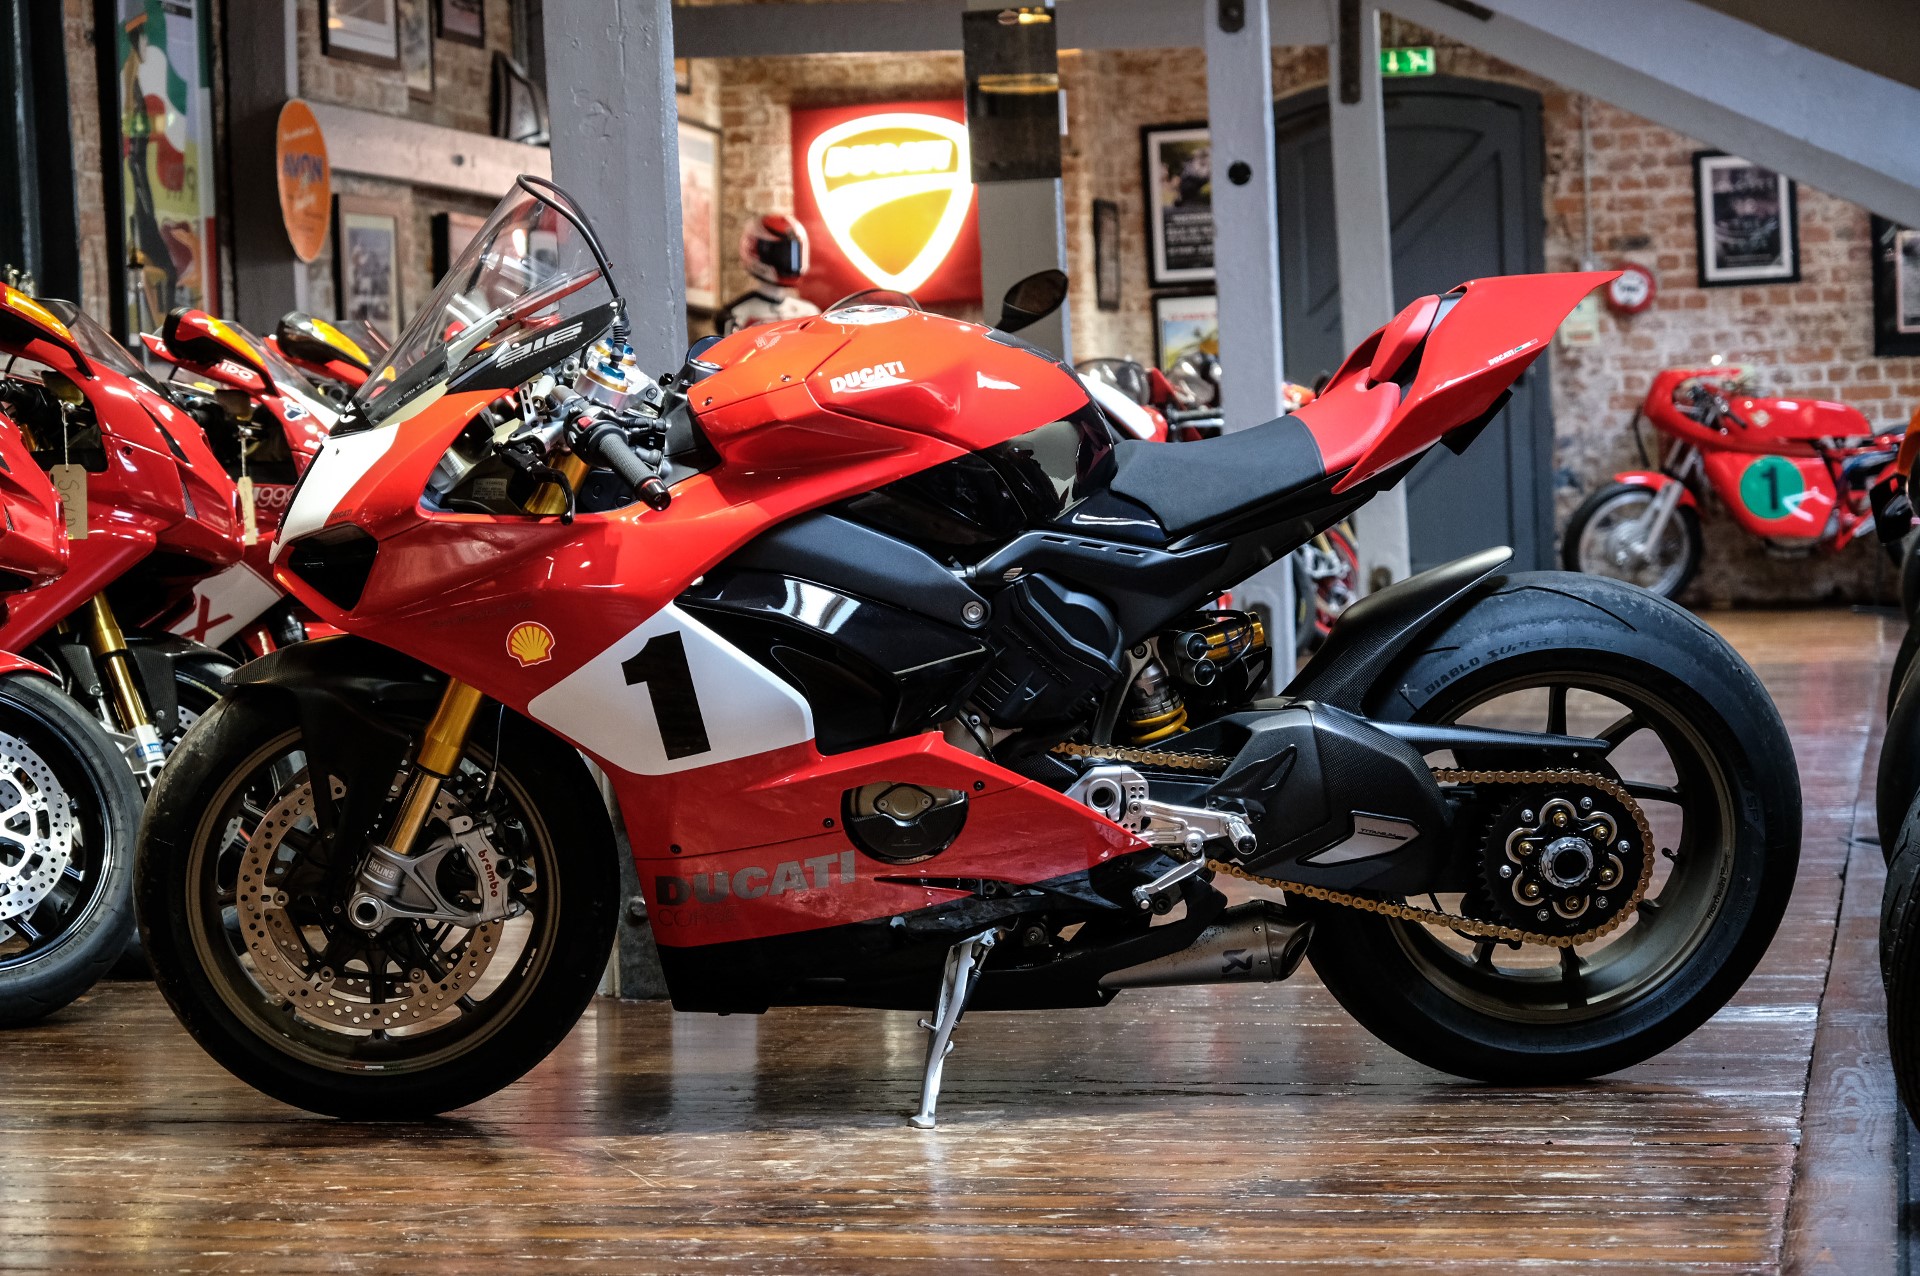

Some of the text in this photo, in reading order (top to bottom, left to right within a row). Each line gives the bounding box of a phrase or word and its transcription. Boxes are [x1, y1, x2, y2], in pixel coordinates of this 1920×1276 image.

[496, 321, 584, 368] 916
[829, 360, 906, 394] DUCATI
[1761, 466, 1779, 511] 1
[621, 630, 712, 761] 1
[1424, 656, 1480, 695] DIABLO
[477, 849, 500, 898] brembo
[655, 849, 856, 907] DUCATI
